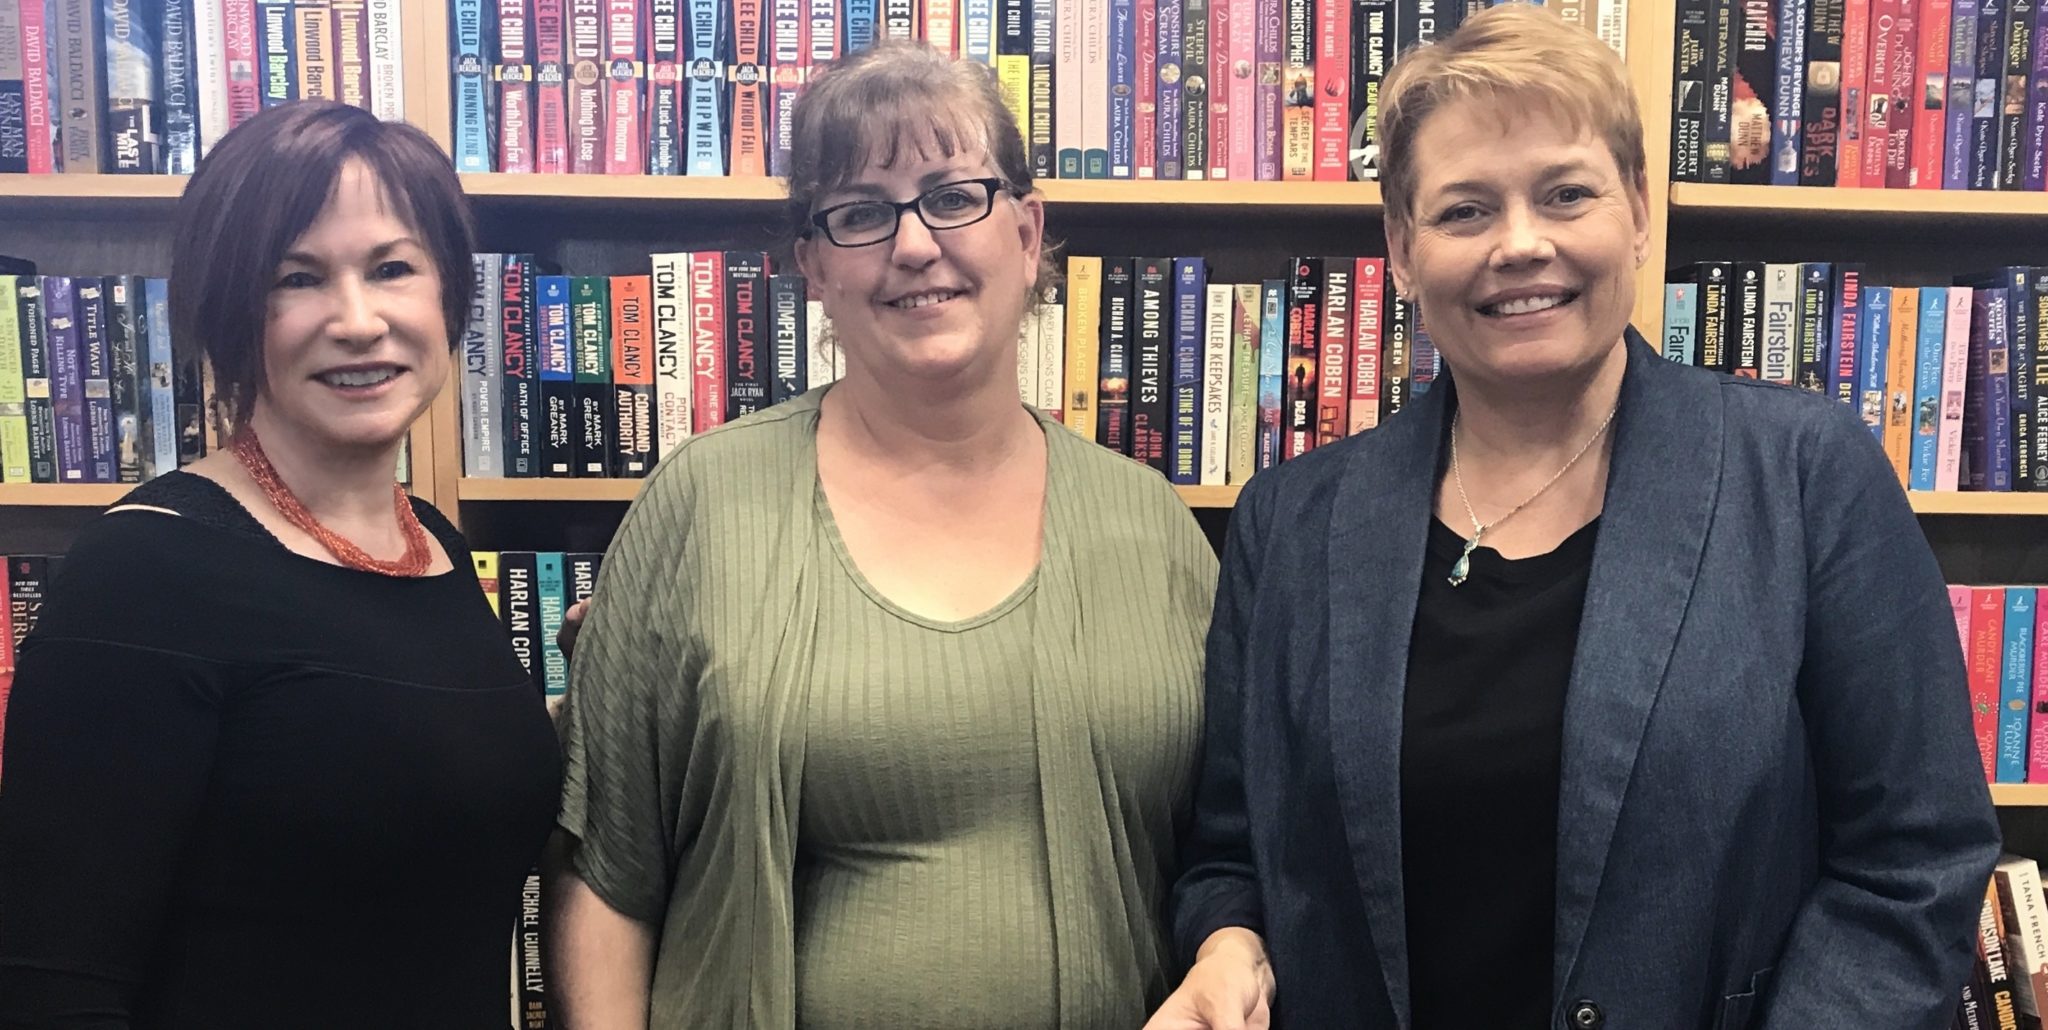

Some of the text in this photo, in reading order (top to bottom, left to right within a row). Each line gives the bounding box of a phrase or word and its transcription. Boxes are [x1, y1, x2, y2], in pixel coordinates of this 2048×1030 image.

[25, 26, 41, 62] DAVID
[304, 11, 324, 61] Linwood
[374, 16, 388, 60] BARCLAY
[461, 10, 476, 46] CHILD
[502, 18, 523, 58] CHILD
[539, 17, 558, 55] CHILD
[575, 16, 597, 57] CHILD
[611, 14, 633, 54] CHILD
[655, 16, 675, 51] CHILD
[695, 10, 711, 48] CHILD
[740, 20, 754, 55] CHILD
[776, 20, 798, 60] CHILD
[811, 19, 834, 60] CHILD
[968, 18, 988, 55] CHILD
[1007, 10, 1020, 36] CHILD
[1196, 20, 1205, 65] STEEPED
[1290, 0, 1303, 68] CHRISTOPHER
[1369, 11, 1383, 76] TOM CLANCY
[1717, 8, 1729, 72] BETRAYAL
[2011, 21, 2024, 68] Danger
[266, 7, 288, 99] Linwood Barclay
[1186, 35, 1195, 60] EVIL
[1681, 30, 1689, 74] MASTER
[1779, 0, 1794, 117] MATTHEW DUNN
[28, 69, 44, 126] BALDACCI
[464, 82, 478, 125] RUNNING
[505, 90, 522, 117] Worth
[1033, 20, 1050, 144] MOON LINCOLN CHILD
[1367, 82, 1377, 103] DEAD
[1712, 85, 1721, 111] DUNN
[1720, 77, 1728, 122] MATTHEW
[1792, 65, 1802, 117] REVENGE
[578, 89, 596, 124] Nothing
[696, 87, 712, 157] TRIPWIRE
[741, 91, 755, 155] WITHOUT FAIL
[779, 92, 796, 150] Persuader
[1163, 90, 1172, 156] LAURA CHILDS
[1301, 111, 1309, 140] SECRET
[117, 133, 128, 169] MILE
[127, 128, 139, 168] LAST
[581, 137, 597, 161] Lose
[1187, 101, 1196, 166] LAURA CHILDS
[1290, 117, 1298, 157] TEMPLARS
[1677, 119, 1688, 176] DUGONI
[1689, 120, 1699, 176] ROBERT
[1750, 114, 1762, 155] MATTHEW
[1803, 123, 1820, 177] SPIES
[1821, 108, 1836, 156] DARK
[503, 262, 525, 378] TOM CLANCY
[623, 297, 640, 378] TOM CLANCY
[656, 262, 678, 379] TOM CLANCY
[694, 259, 715, 379] TOM CLANCY
[737, 282, 753, 379] TOM CLANCY
[1111, 297, 1125, 331] RICHARD
[1143, 290, 1160, 338] AMONG
[1180, 294, 1195, 334] RICHARD
[1290, 308, 1302, 345] COBEN
[1303, 304, 1316, 349] HARLAN
[1323, 273, 1347, 397] HARLAN COBEN
[1358, 299, 1378, 350] HARLAN
[1704, 285, 1720, 366] LINDA FAIRSTEIN
[1741, 286, 1757, 367] LINDA FAIRSTEIN
[1803, 288, 1817, 363] LINDA FAIRSTEIN
[1838, 272, 1859, 377] LINDA FAIRSTEIN
[1988, 302, 1997, 340] Ferris
[1996, 297, 2004, 345] Monica
[27, 303, 40, 375] POISONED PAGES
[66, 350, 76, 368] NOT
[87, 304, 100, 376] TITLE WAVE
[549, 304, 565, 373] TOM CLANCY
[582, 302, 598, 375] TOM CLANCY
[1110, 344, 1122, 373] CLARKE
[1392, 324, 1404, 365] COBEN
[1767, 301, 1792, 379] Fairstein
[1933, 343, 1942, 363] One
[2017, 315, 2027, 400] RIVER NIGHT
[2035, 296, 2048, 385] SOMETIMES LIE
[56, 336, 68, 398] KILLING TYPE
[1141, 345, 1158, 403] THIEVES
[1207, 313, 1224, 413] KILLER KEEPSAKES
[1241, 351, 1251, 395] TREASURE
[1356, 354, 1376, 395] COBEN
[1921, 362, 1931, 390] Grave
[519, 383, 530, 454] OATH OF OFFICE
[709, 385, 718, 409] LINE
[1294, 400, 1306, 427] DEAL
[549, 396, 559, 449] GREANEY
[558, 414, 567, 445] MARK
[584, 397, 593, 450] GREANEY
[592, 413, 602, 446] MARK
[617, 390, 634, 456] AUTHORITY
[634, 394, 650, 453] COMMAND
[1149, 428, 1162, 457] JOHN
[1177, 388, 1194, 475] STING OF THE DRONE
[2019, 414, 2027, 478] ERICA FERENCIK
[2036, 396, 2048, 460] ALICE FEENEY
[510, 569, 529, 631] HARLAN
[541, 597, 562, 646] HARLAN
[545, 649, 565, 688] COBEN
[1976, 630, 1985, 672] MURDER
[1985, 619, 1997, 684] CANDY CANE
[2008, 640, 2017, 680] MURDER
[2017, 627, 2027, 679] BLACKBERRY
[1985, 731, 1993, 775] JOANNE
[2003, 724, 2013, 759] FLUKE
[2011, 717, 2021, 765] JOANNE
[522, 875, 544, 992] MICHAEL CONNELLY
[2022, 881, 2046, 959] TANA FRENCH
[1988, 954, 2007, 983] LAKE
